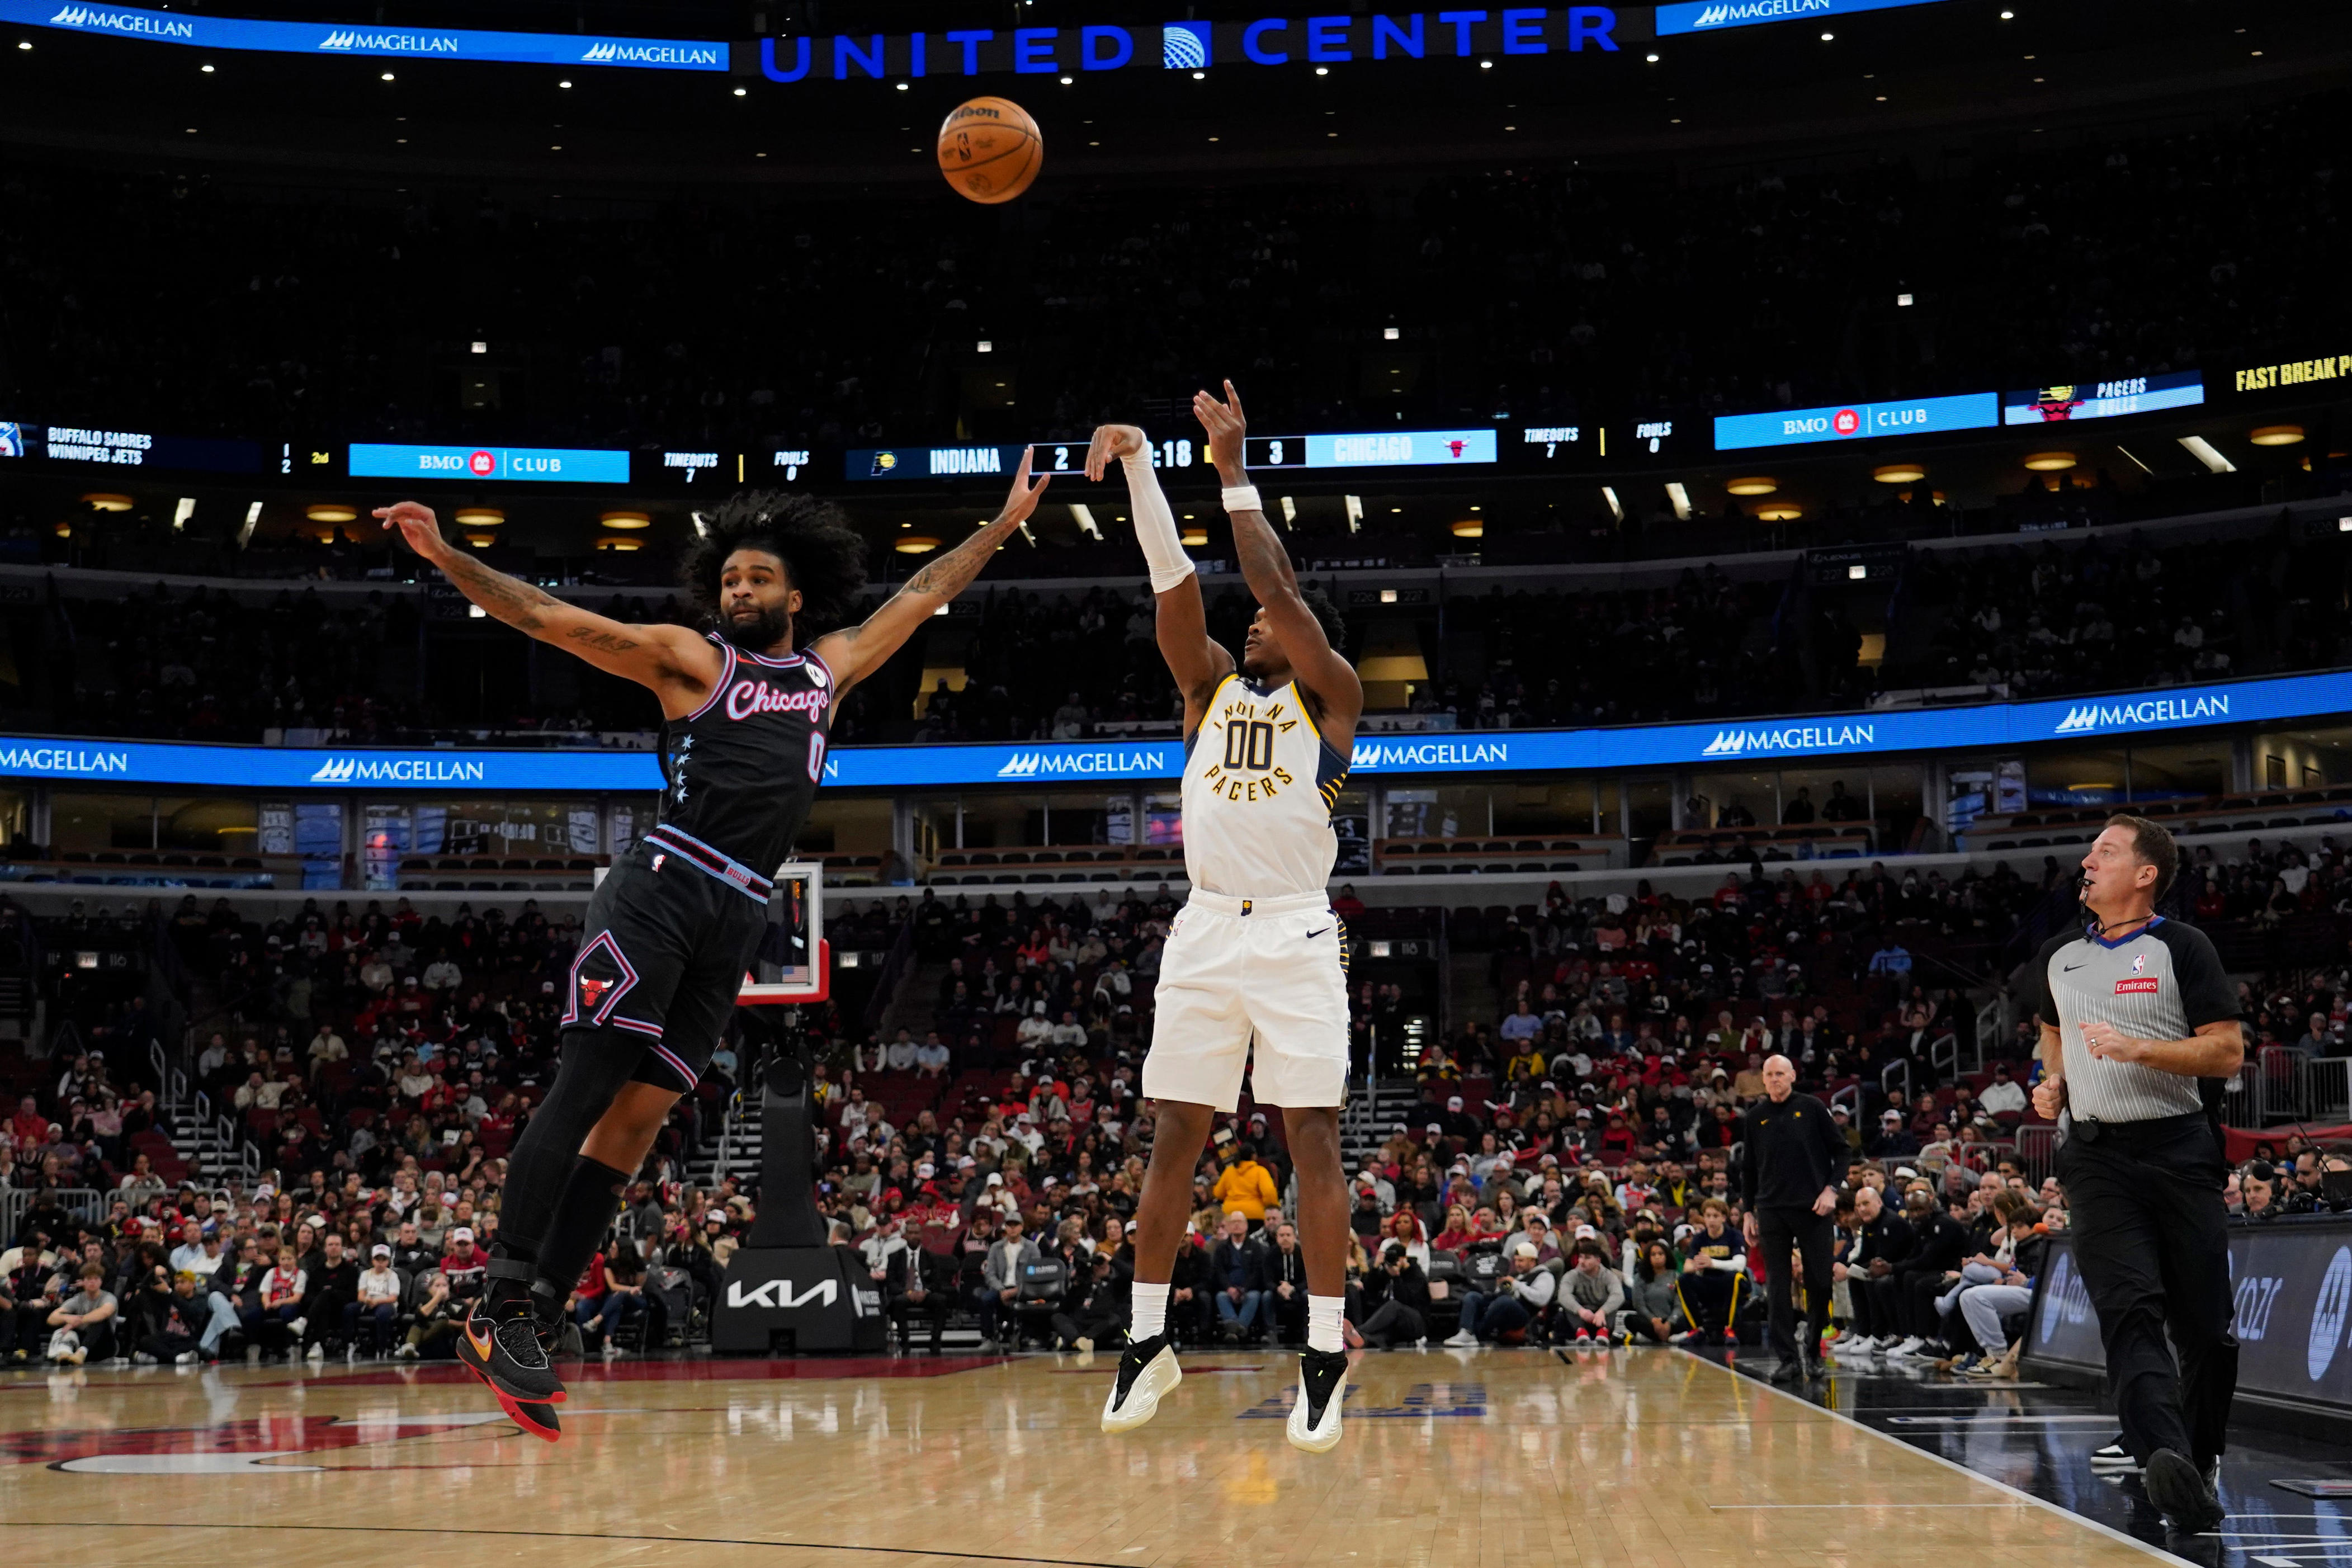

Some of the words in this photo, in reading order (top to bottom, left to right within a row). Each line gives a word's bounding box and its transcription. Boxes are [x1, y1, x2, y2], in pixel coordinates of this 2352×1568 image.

[1728, 0, 1830, 21] MAGELLAN
[87, 11, 192, 38] MAGELLAN
[355, 32, 457, 54] MAGELLAN
[761, 26, 1134, 83] UNITED
[1242, 6, 1619, 65] CENTER
[616, 45, 716, 64] MAGELLAN
[2236, 366, 2278, 391] FAST
[2280, 357, 2337, 385] BREAK
[2098, 377, 2147, 399] PACERS
[1636, 422, 1672, 438] FOULS
[1783, 417, 1828, 435] BMO
[1878, 408, 1928, 427] CLUB
[48, 427, 103, 446] BUFFALO
[103, 431, 152, 450] SABRES
[1524, 427, 1579, 443] TIMEOUTS
[48, 443, 110, 462] WINNIPEG
[111, 448, 143, 465] JETS
[311, 451, 329, 464] 2nd
[664, 452, 718, 467] TIMEOUTS
[774, 451, 810, 466] FOULS
[1055, 447, 1069, 471] 2
[1269, 441, 1283, 465] 3
[1334, 436, 1413, 463] CHICAGO
[1546, 443, 1556, 459] 7
[281, 459, 291, 474] 2
[419, 454, 464, 470] BMO
[513, 457, 562, 473] CLUB
[930, 448, 1002, 475] INDIANA
[686, 467, 695, 483] 7
[786, 465, 797, 481] 0
[727, 680, 829, 723] Chicago
[2100, 694, 2229, 727] MAGELLAN
[1222, 719, 1274, 771] 00
[1747, 724, 1874, 752] MAGELLAN
[0, 749, 127, 773] MAGELLAN
[807, 730, 825, 783] 0
[1041, 752, 1164, 773] MAGELLAN
[1383, 743, 1507, 765] MAGELLAN
[356, 761, 484, 782] MAGELLAN
[1203, 763, 1294, 802] PACERS
[726, 867, 749, 886] BULLS
[2116, 980, 2157, 991] Emirates
[728, 1279, 838, 1307] KIA
